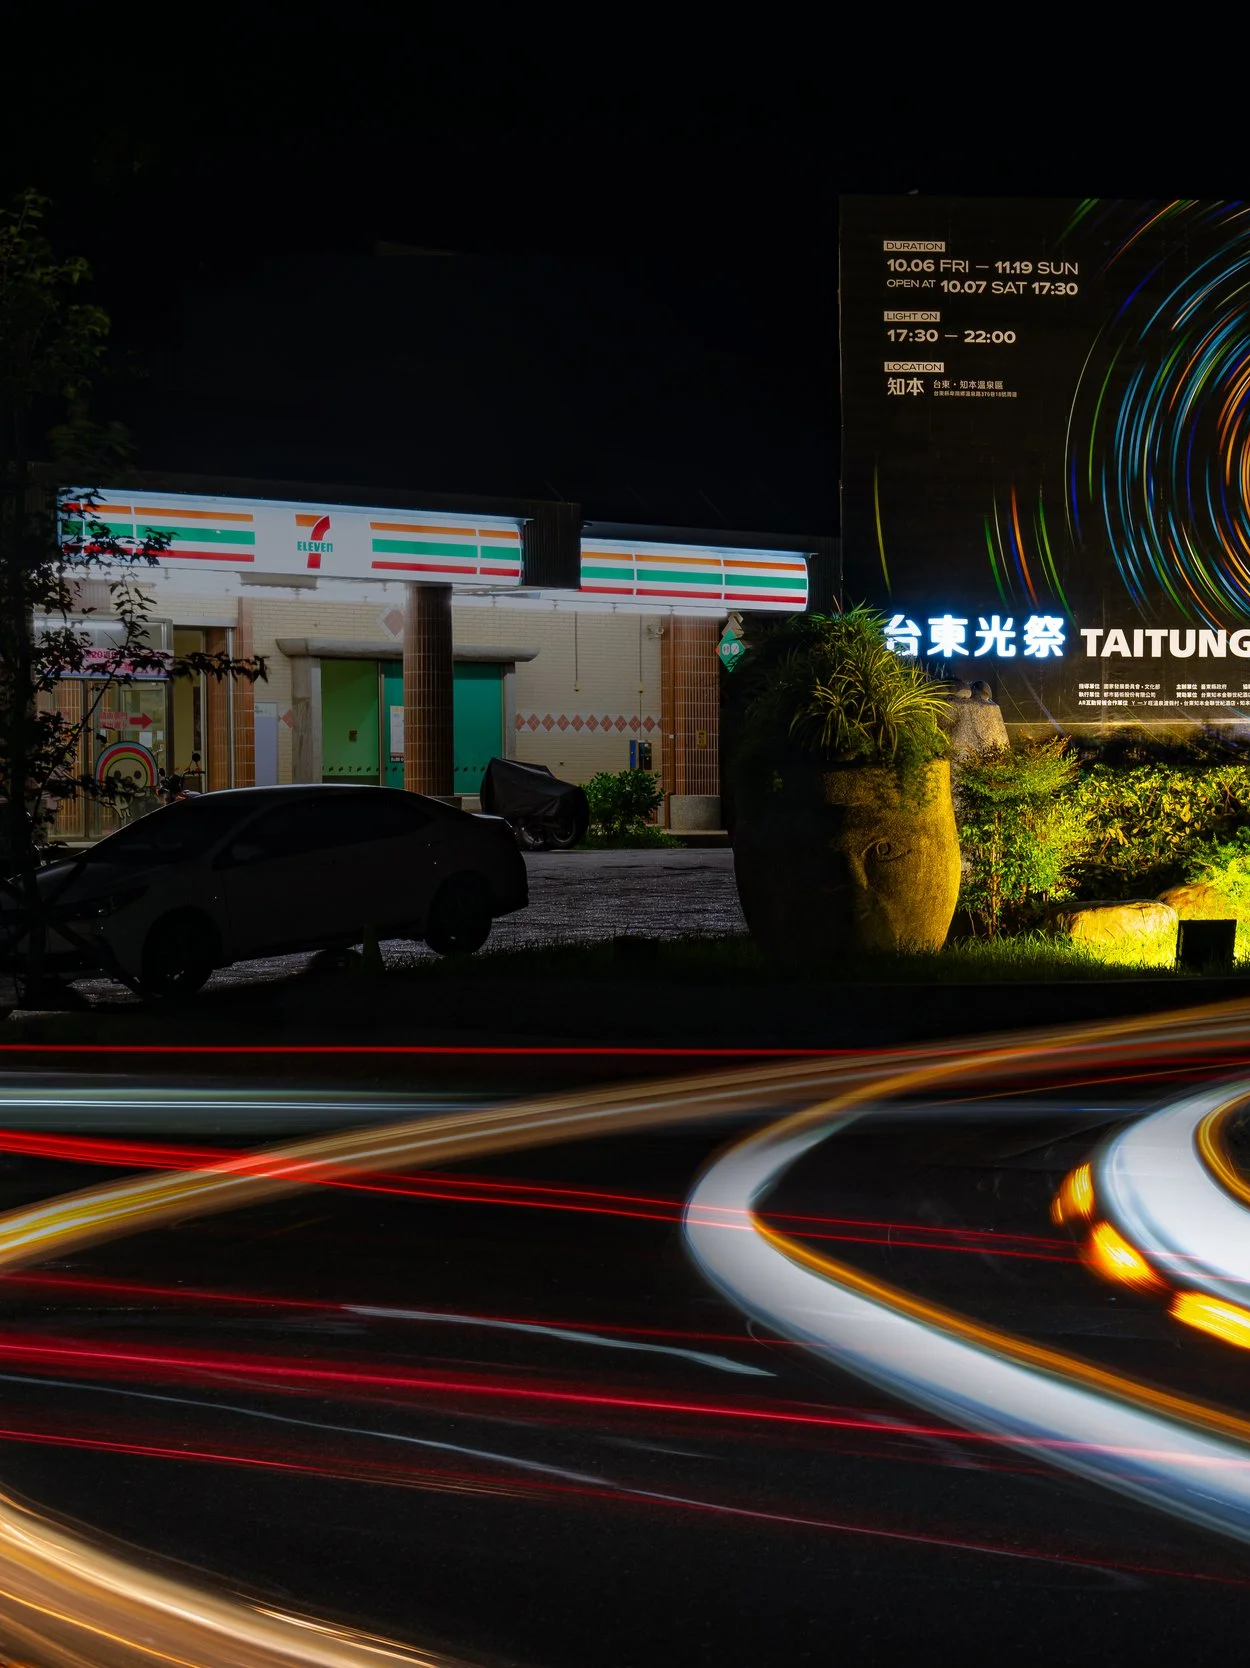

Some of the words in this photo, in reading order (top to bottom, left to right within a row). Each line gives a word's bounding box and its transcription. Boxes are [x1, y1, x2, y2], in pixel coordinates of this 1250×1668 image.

[886, 242, 943, 250] DURATION
[887, 259, 935, 272] 10.06
[940, 260, 969, 273] FRI
[995, 261, 1033, 274] 11.19
[1037, 262, 1079, 275] SUN
[886, 279, 920, 288] OPEN
[921, 279, 936, 288] AT
[940, 280, 987, 293] 10.07
[991, 281, 1027, 294] SAT
[1031, 282, 1079, 295] 17:30
[886, 313, 918, 321] LIGHT
[920, 313, 938, 321] ON
[887, 329, 939, 342] 17:30
[964, 330, 1016, 344] 22:00
[887, 363, 942, 371] LOCATION
[887, 377, 924, 396] 知本
[883, 614, 1066, 658] 台東光祭
